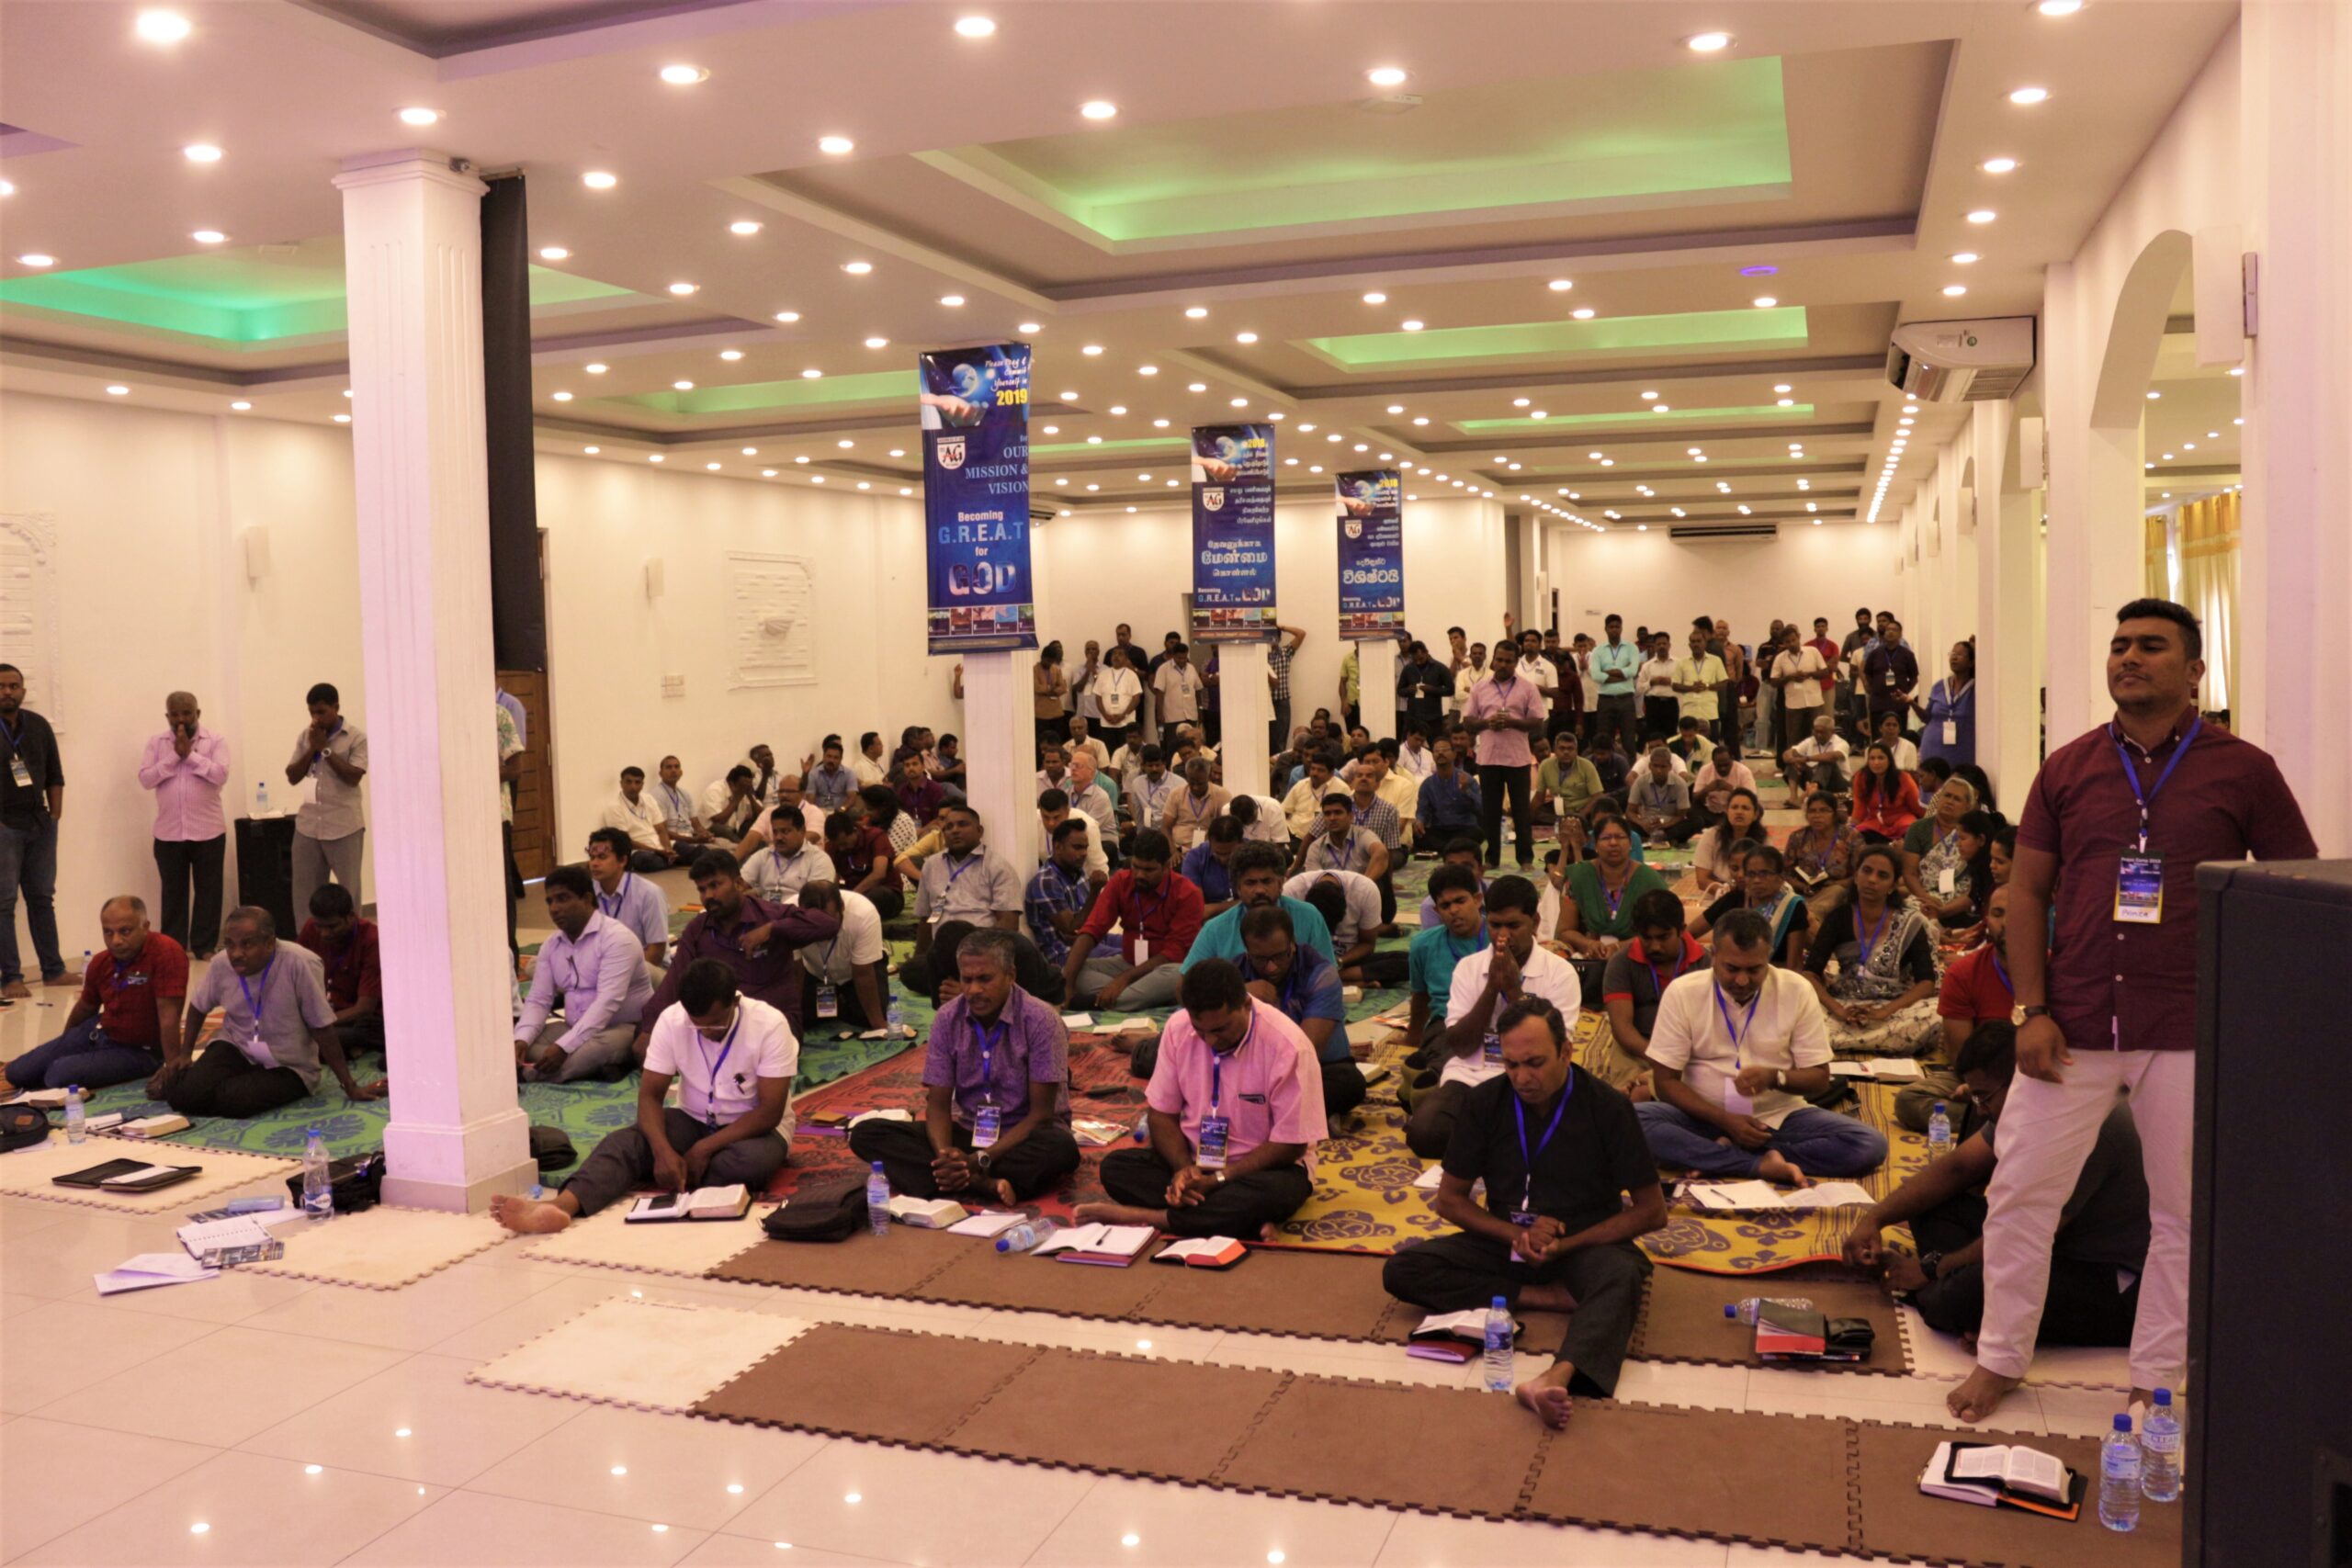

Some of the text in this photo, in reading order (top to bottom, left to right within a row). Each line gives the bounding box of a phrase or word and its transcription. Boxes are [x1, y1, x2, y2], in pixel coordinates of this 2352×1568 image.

[996, 389, 1028, 406] 2019
[1003, 446, 1028, 458] OUR
[965, 463, 1028, 479] MISSION &
[988, 481, 1028, 494] VISION
[957, 510, 1003, 522] Becoming
[938, 522, 1023, 544] G.R.E.A.T
[975, 547, 989, 556] for
[1201, 549, 1268, 565] மேன்மை
[948, 561, 1016, 595] GOD
[1342, 568, 1399, 583] විශිෂ්ටයි
